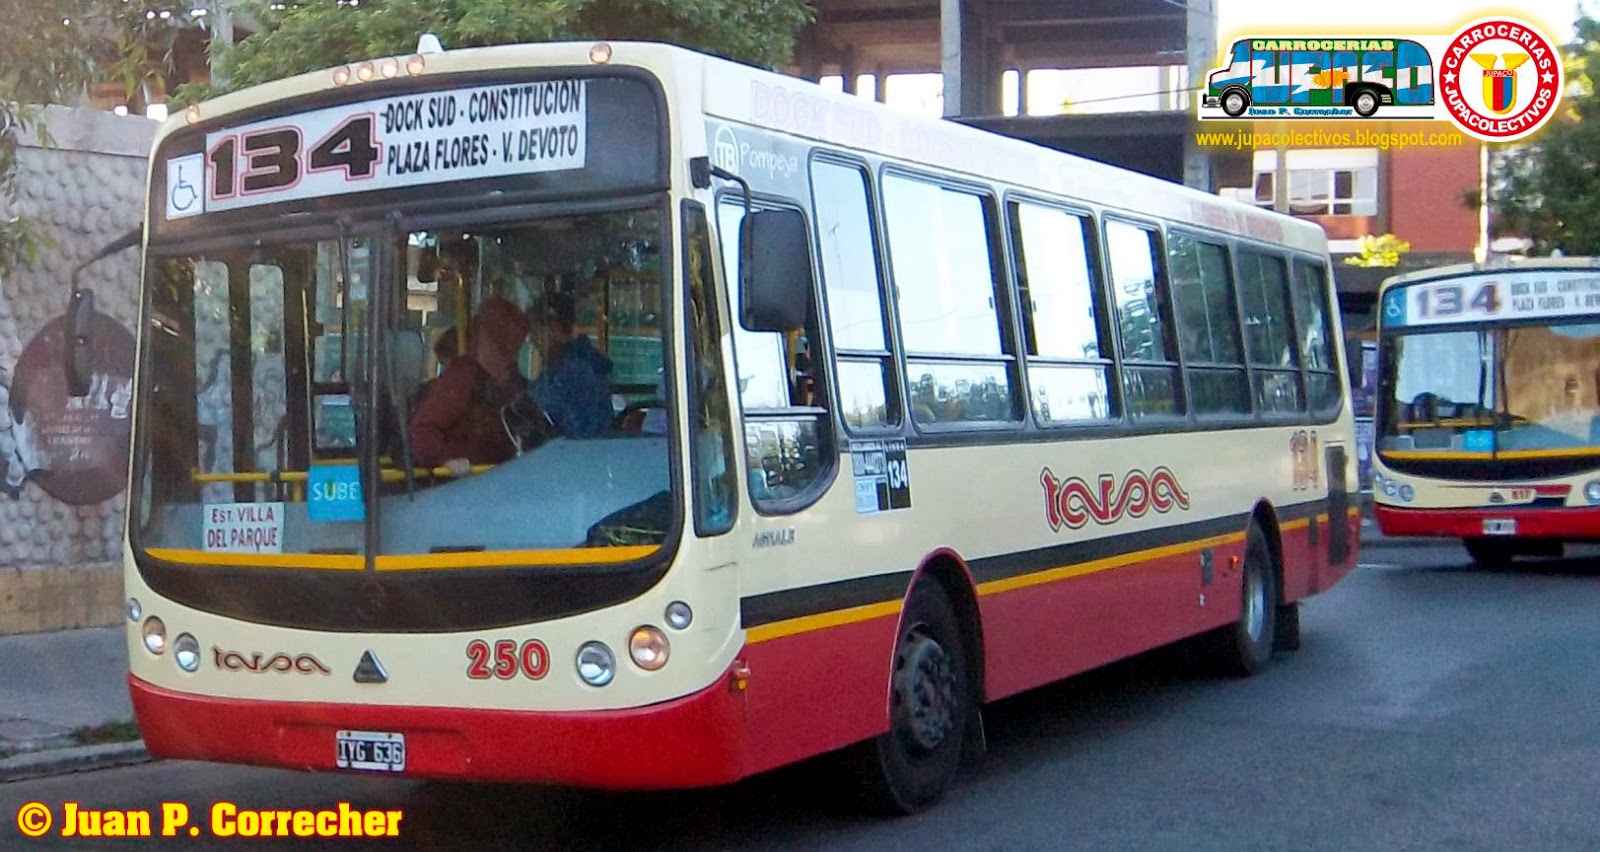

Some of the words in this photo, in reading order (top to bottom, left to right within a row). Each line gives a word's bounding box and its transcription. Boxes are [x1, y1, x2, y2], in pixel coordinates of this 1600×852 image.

[384, 98, 424, 134] DOCK
[428, 95, 456, 128] SUD
[206, 112, 382, 201] 134
[387, 141, 430, 175] PLAZA
[435, 134, 489, 170] FLORES
[502, 131, 513, 163] V.
[518, 124, 578, 161] DEVOTO
[740, 142, 799, 179] Pompeya
[1417, 281, 1501, 318] 134
[313, 481, 361, 501] SUBE
[887, 459, 908, 490] 134
[238, 507, 274, 522] VILLA
[207, 529, 227, 548] DEL
[231, 527, 277, 552] PARQUE
[466, 638, 550, 681] 250
[338, 740, 366, 761] IYG
[373, 742, 403, 764] 636
